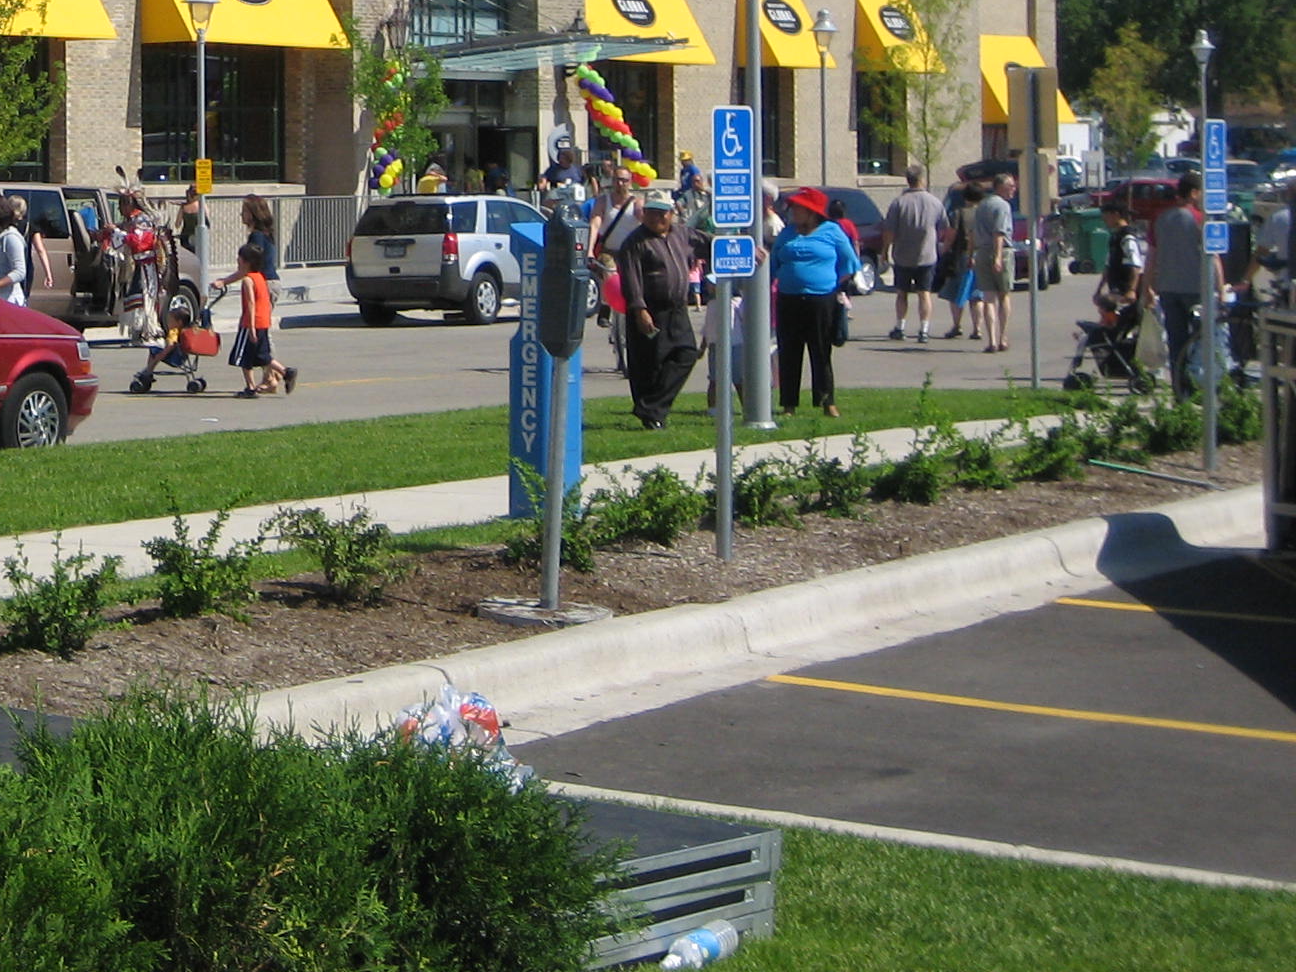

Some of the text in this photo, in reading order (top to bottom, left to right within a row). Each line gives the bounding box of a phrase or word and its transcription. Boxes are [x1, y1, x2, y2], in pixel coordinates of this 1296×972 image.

[616, 0, 650, 13] GLOBAL
[726, 243, 741, 255] VAN
[715, 257, 752, 269] ACCESSIBLE
[520, 253, 538, 453] EMERGENCY
